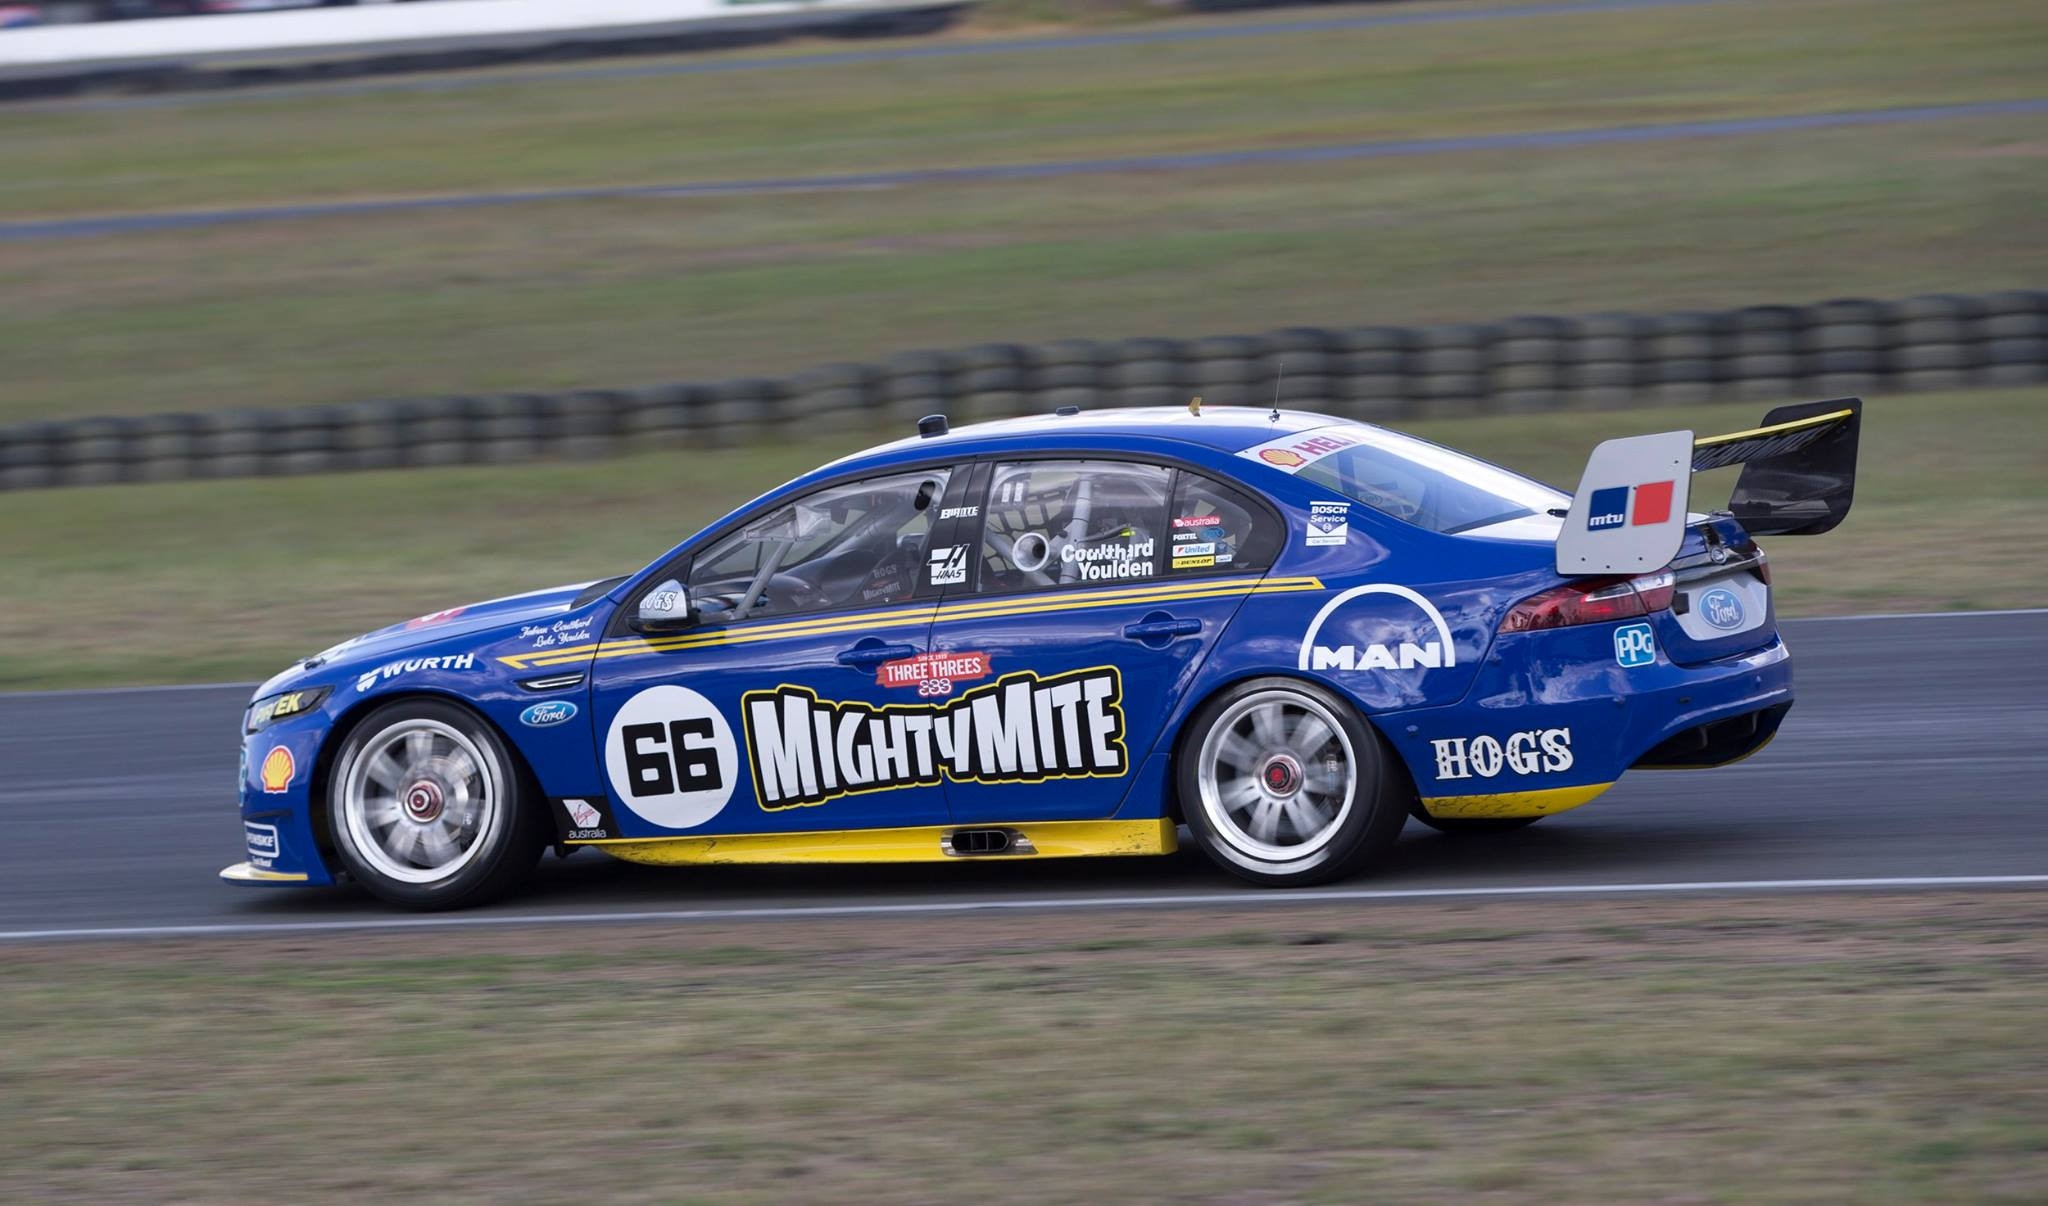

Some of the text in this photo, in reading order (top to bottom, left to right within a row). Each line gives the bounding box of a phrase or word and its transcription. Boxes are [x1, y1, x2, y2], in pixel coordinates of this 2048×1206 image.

[1311, 505, 1348, 514] BOSCH
[1311, 514, 1347, 523] Service
[1589, 513, 1624, 527] mtu
[1183, 516, 1220, 527] australia
[1061, 538, 1154, 563] Coulthard
[1184, 546, 1210, 554] United
[1078, 558, 1153, 580] Youlden
[1180, 558, 1212, 566] DUNLOP
[1707, 593, 1740, 625] Ford
[1617, 629, 1652, 662] PPG
[1312, 642, 1441, 671] MAN
[886, 657, 982, 682] THREE THREES
[531, 704, 567, 724] Ford
[750, 675, 1120, 802] MIGHTYMITE
[621, 717, 723, 798] 66
[568, 829, 608, 839] australia
